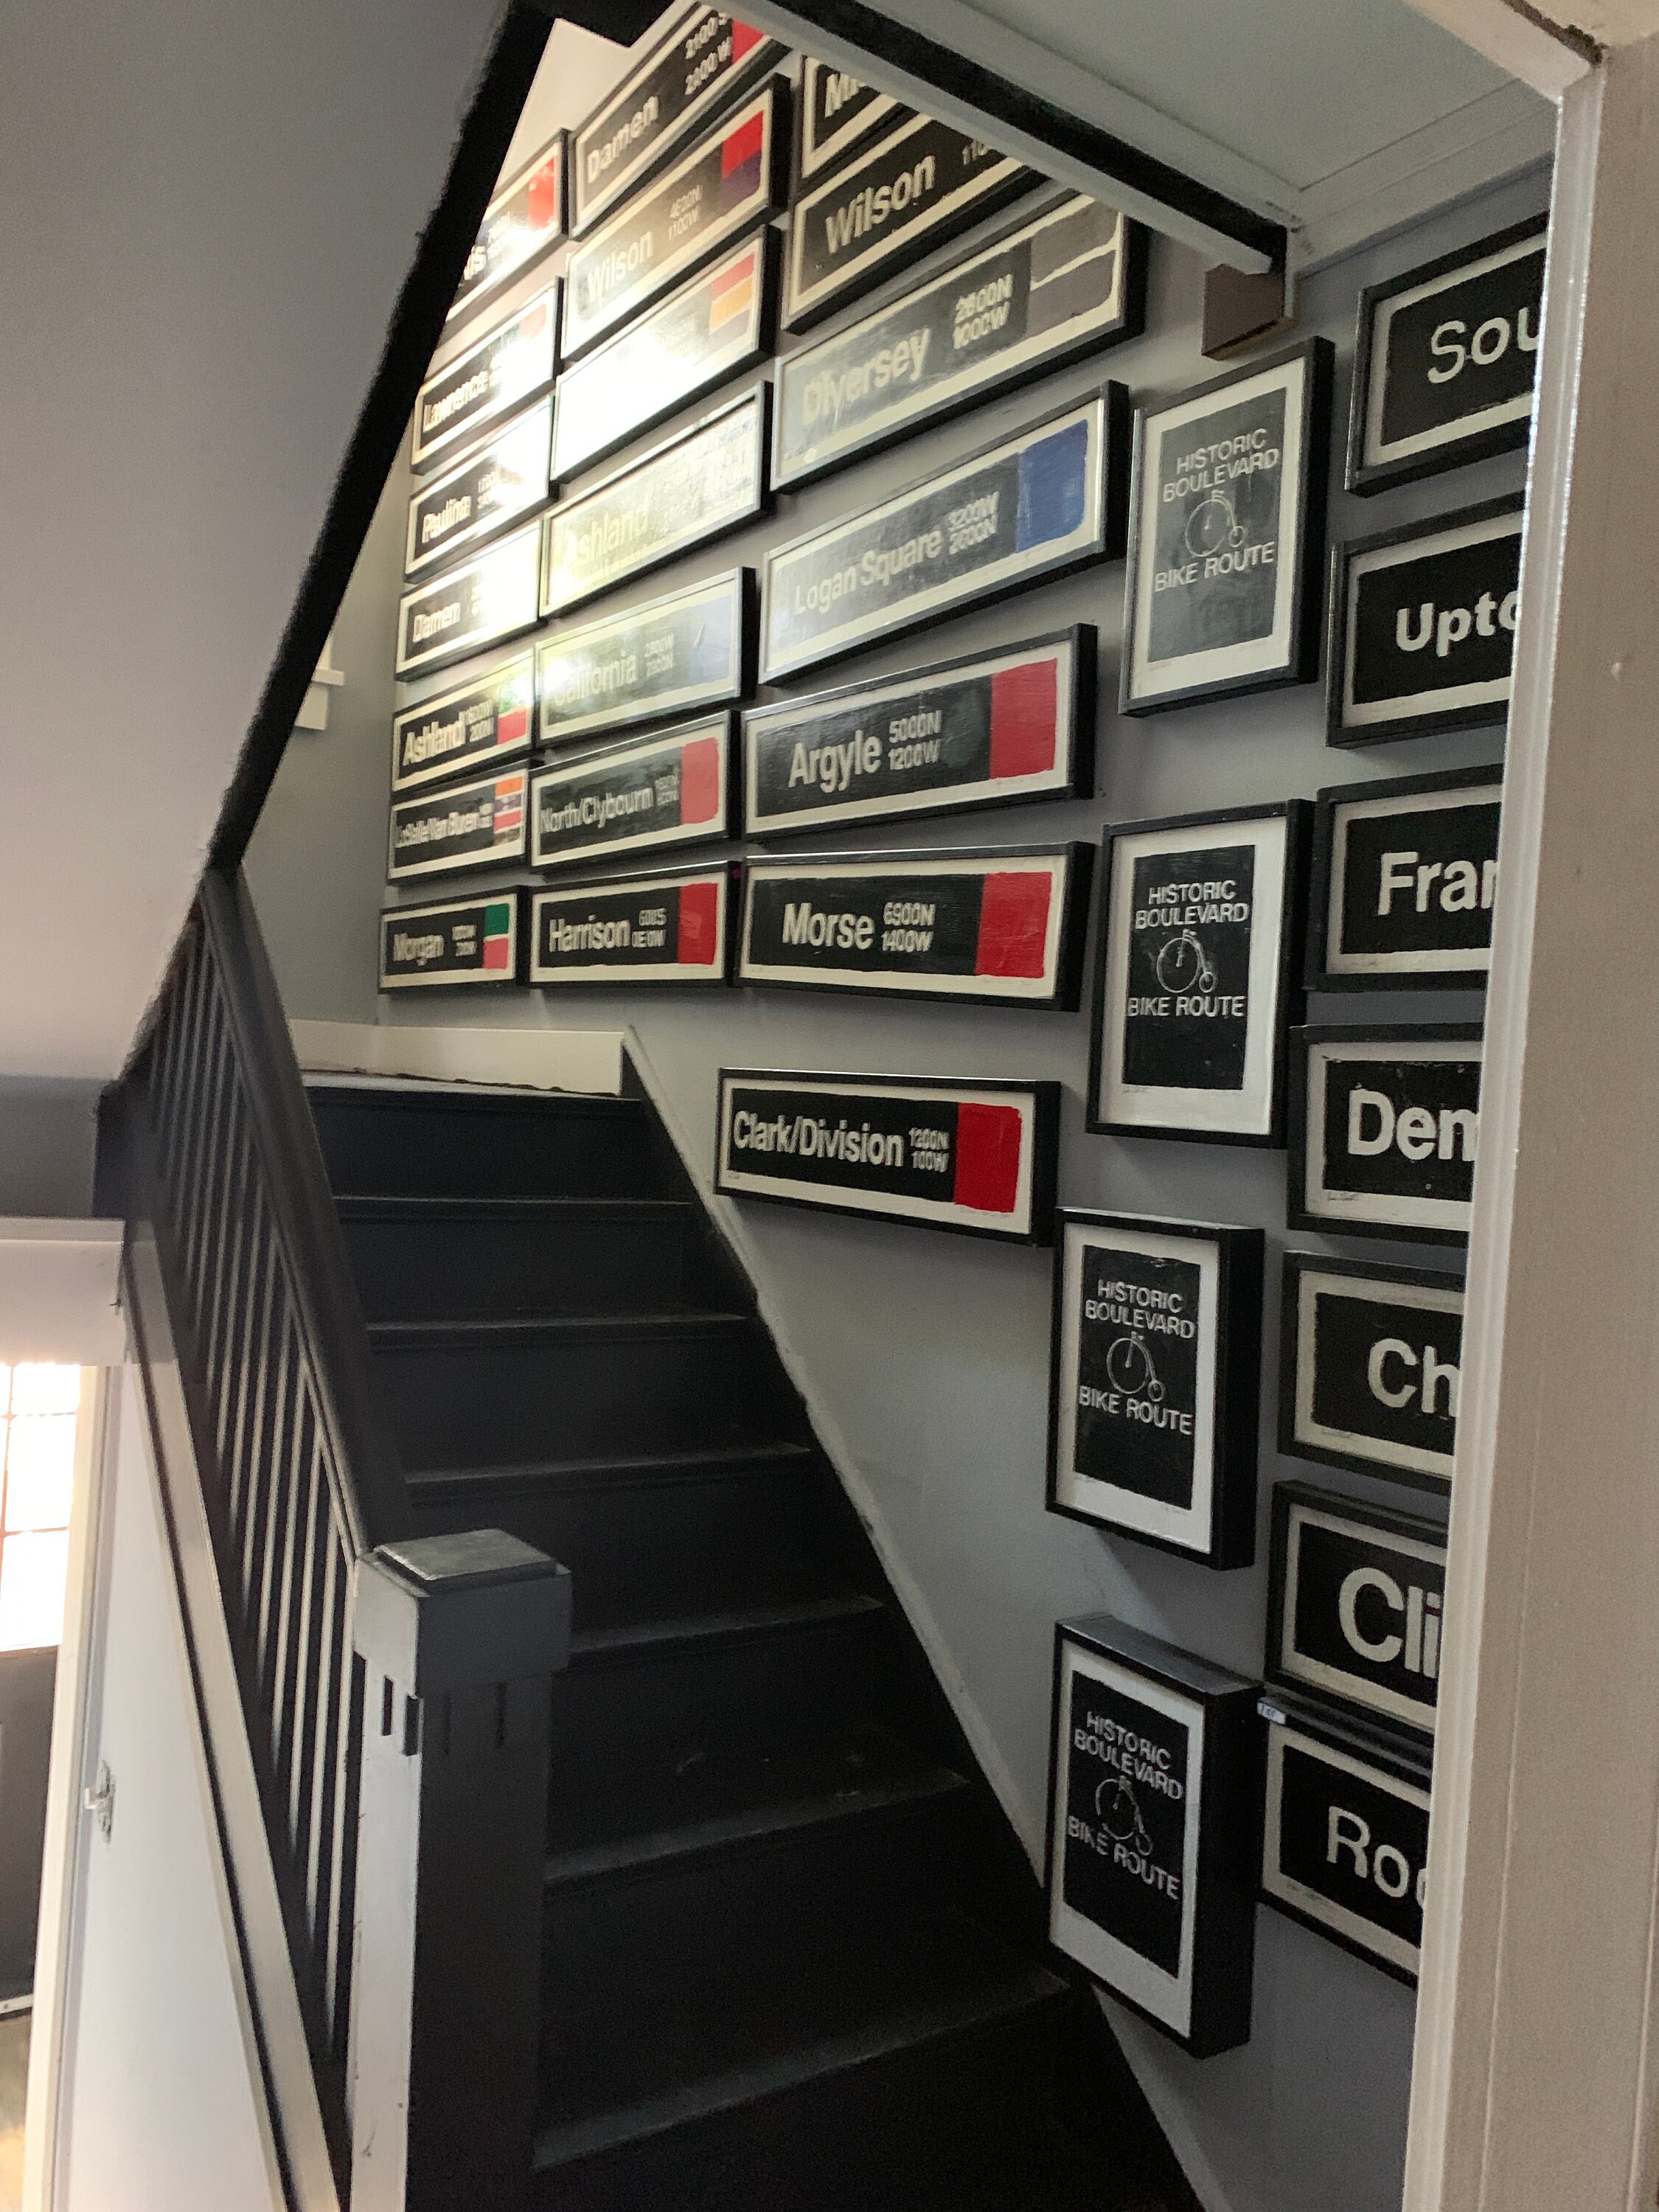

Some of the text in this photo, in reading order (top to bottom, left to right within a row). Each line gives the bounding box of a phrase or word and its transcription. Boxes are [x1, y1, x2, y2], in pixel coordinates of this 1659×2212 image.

[588, 96, 658, 184] Damen
[826, 156, 936, 254] Wilson
[588, 232, 654, 303] Wilson
[802, 328, 931, 426] Diversey
[1163, 448, 1279, 502] BOULEVARD
[1177, 428, 1267, 474] HISTORIC
[794, 529, 943, 616] Logan Square
[1155, 541, 1275, 592] BIKE ROUTE
[413, 602, 461, 643] Damen
[403, 711, 467, 766] Ashland
[888, 709, 942, 743] 5000N
[787, 729, 883, 793] Argyle
[888, 738, 942, 771] 1200W
[883, 901, 936, 927] 6900N
[1135, 902, 1249, 929] BOULEVARD
[1148, 880, 1236, 905] HISTORIC
[549, 914, 630, 952] Harrison
[782, 902, 875, 949] Morse
[881, 929, 934, 952] 1400W
[1127, 996, 1245, 1018] BIKE ROUTE
[733, 1110, 904, 1167] Clark/Division
[908, 1127, 950, 1151] 1200N
[911, 1150, 949, 1173] 100W
[1085, 1299, 1196, 1339] BOULEVARD
[1097, 1279, 1183, 1313] HISTORIC
[1079, 1385, 1193, 1436] BIKE ROUTE
[1074, 1728, 1183, 1800] BOULEVARD
[1086, 1711, 1172, 1770] HISTORIC
[1068, 1815, 1180, 1900] BIKE ROUTE
[1326, 1806, 1426, 1909] Ro
